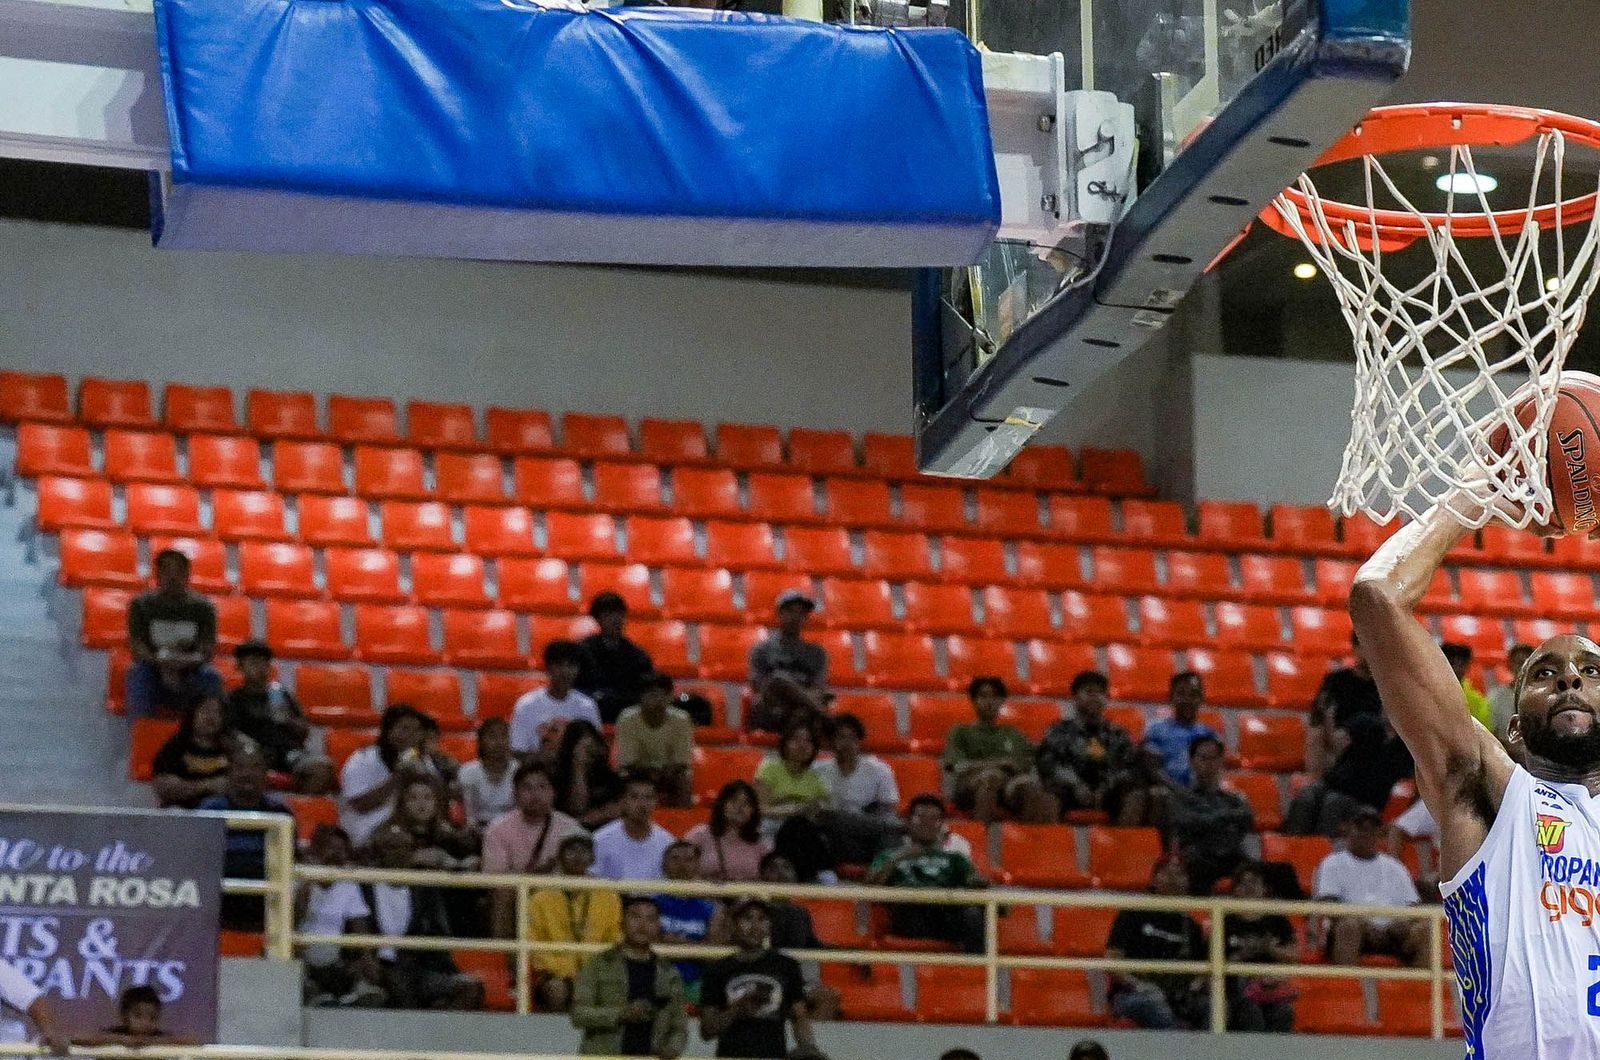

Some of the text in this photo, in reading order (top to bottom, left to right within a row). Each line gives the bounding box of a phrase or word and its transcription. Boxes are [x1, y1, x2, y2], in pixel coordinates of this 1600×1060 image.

[1556, 427, 1600, 532] SPALDING
[88, 876, 200, 909] ROSA
[77, 917, 119, 959] &
[12, 953, 187, 1003] RANTS
